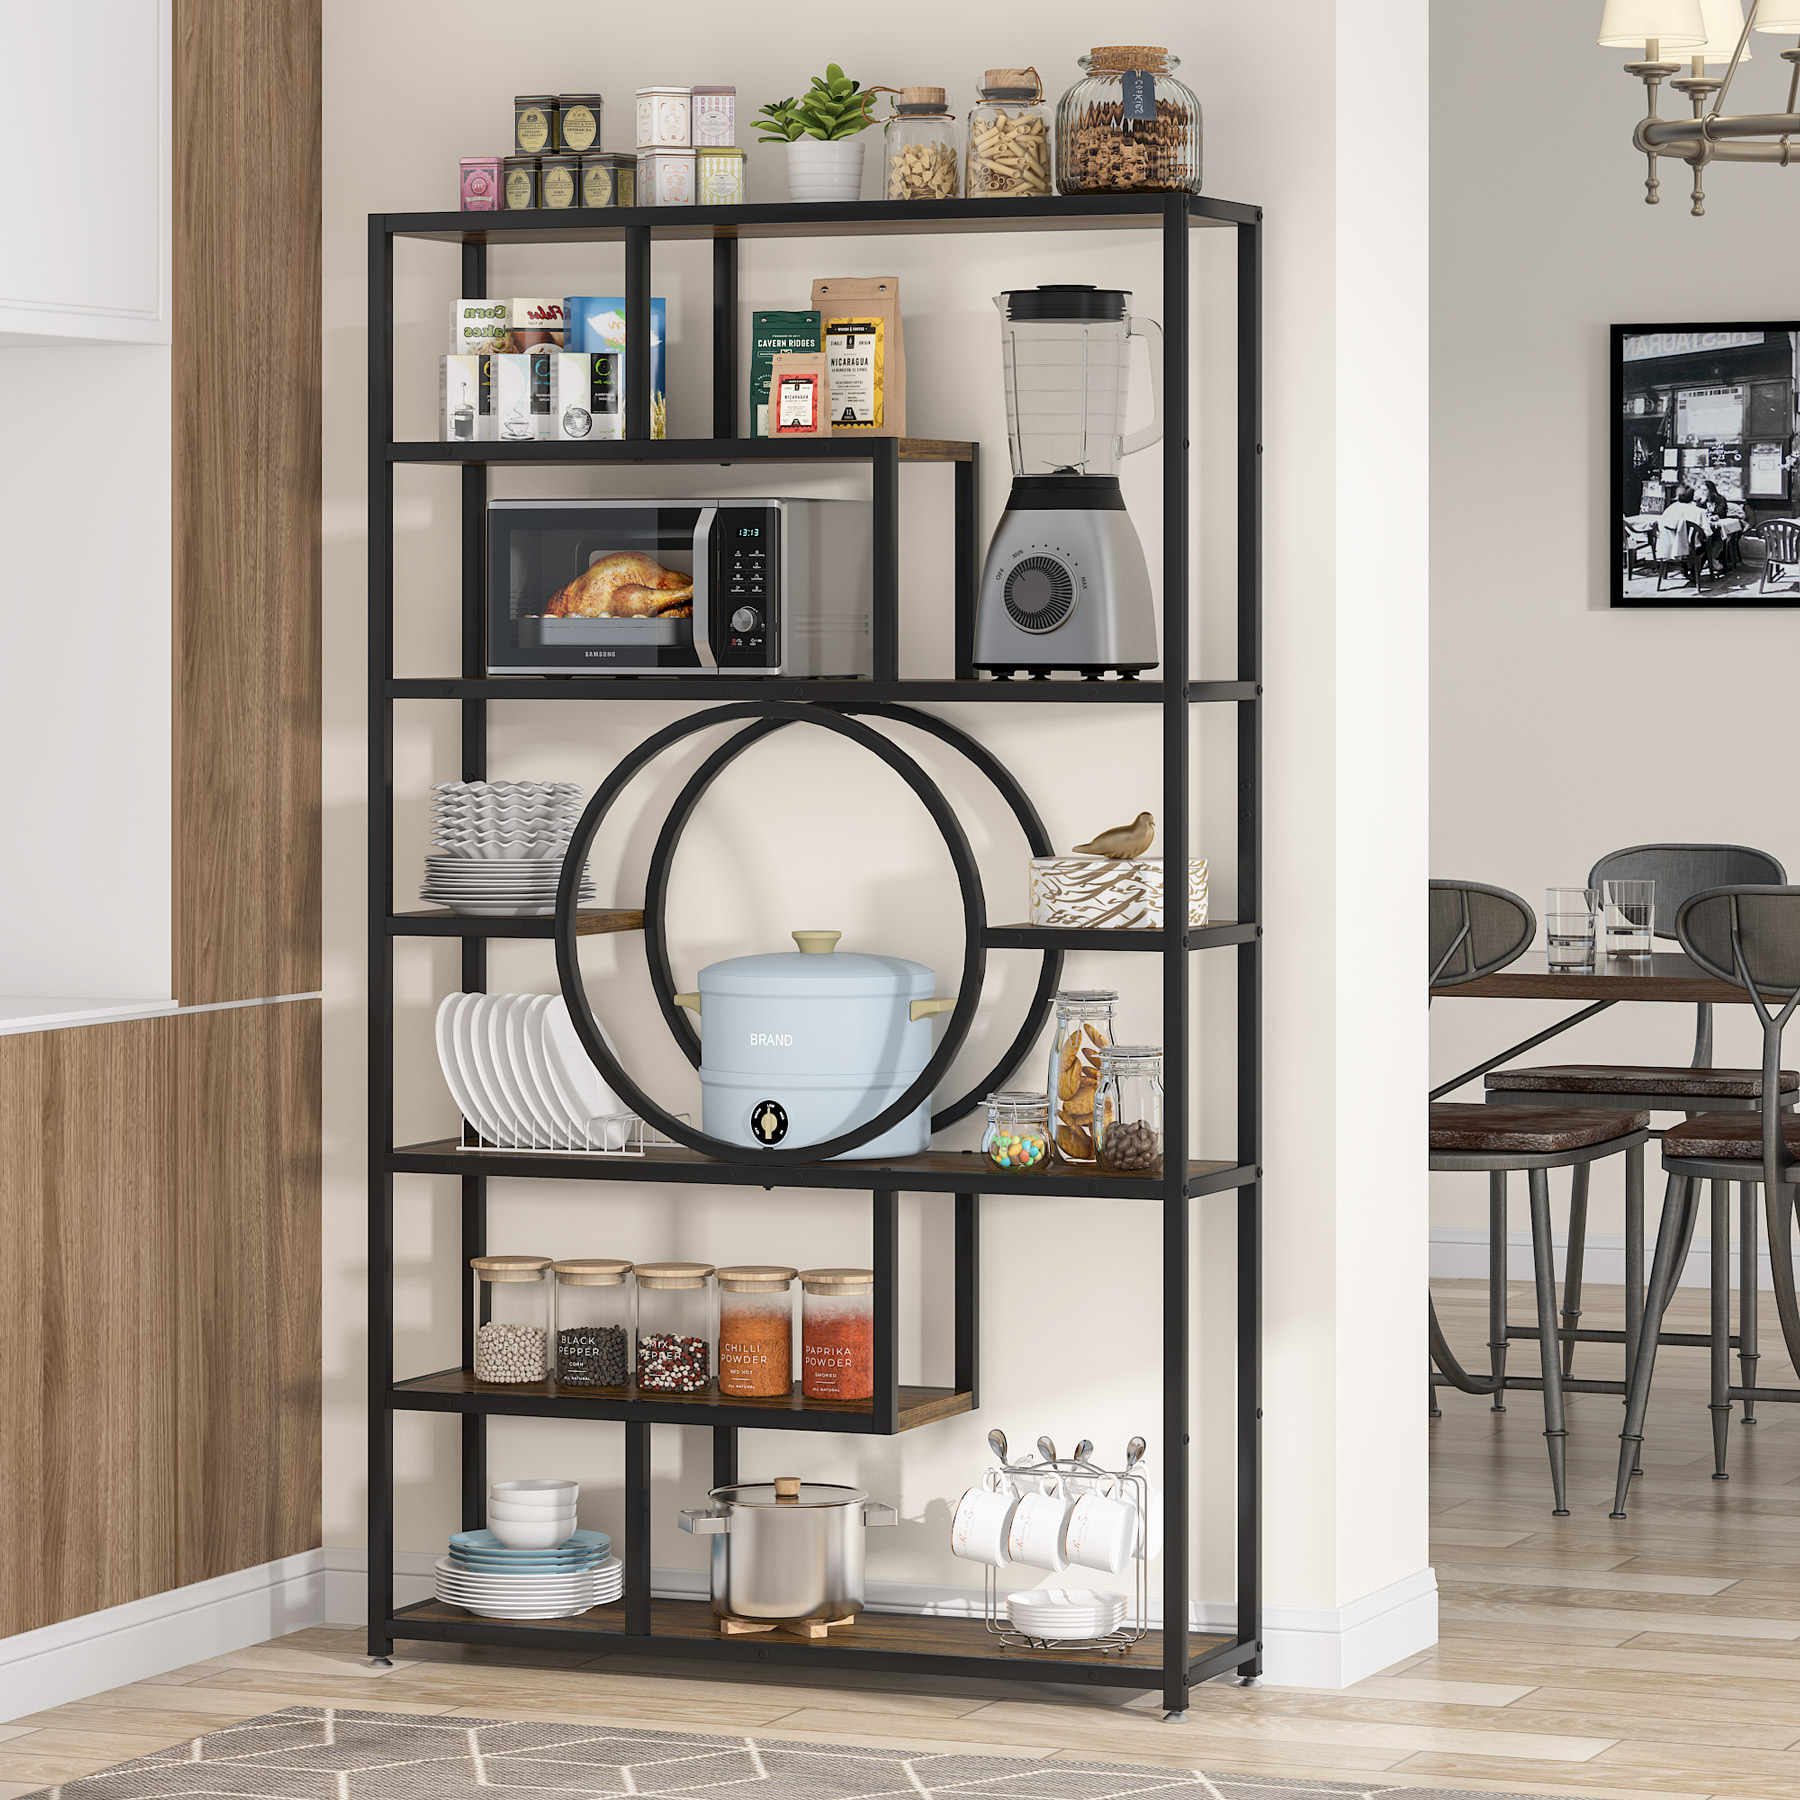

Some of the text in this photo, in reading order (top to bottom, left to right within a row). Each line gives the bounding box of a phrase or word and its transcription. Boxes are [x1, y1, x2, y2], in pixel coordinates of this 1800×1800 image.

[758, 339, 815, 347] CAVERN RIDGES
[830, 357, 868, 367] NICARAGUA
[739, 528, 759, 537] 13:13
[1012, 549, 1024, 559] MIN
[996, 568, 1005, 581] OFF
[1080, 576, 1088, 590] MAX
[750, 1033, 793, 1047] BRAND
[561, 1335, 596, 1345] BLACK
[649, 1340, 669, 1348] MIX
[558, 1346, 600, 1356] PEPPER
[725, 1343, 760, 1353] CHILLI
[805, 1345, 852, 1356] PAPRIKA
[640, 1350, 682, 1360] PEPPER
[721, 1353, 768, 1364] POWDER
[805, 1357, 852, 1367] POWDER
